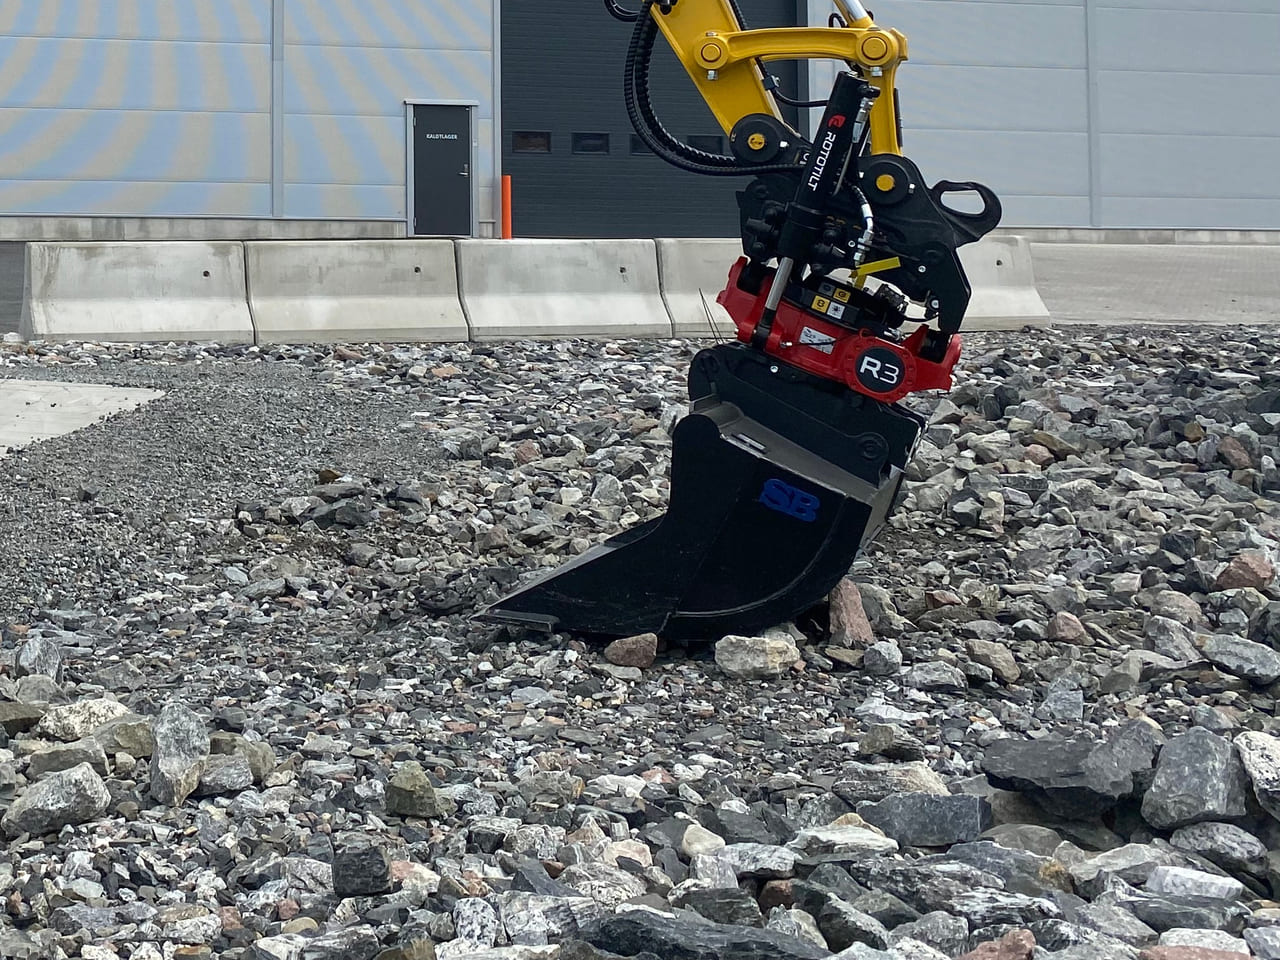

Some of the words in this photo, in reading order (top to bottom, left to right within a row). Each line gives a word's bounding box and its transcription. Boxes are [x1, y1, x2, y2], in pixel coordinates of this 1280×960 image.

[807, 131, 837, 192] ROTOTILT
[860, 356, 900, 385] R3
[759, 478, 820, 522] SB
